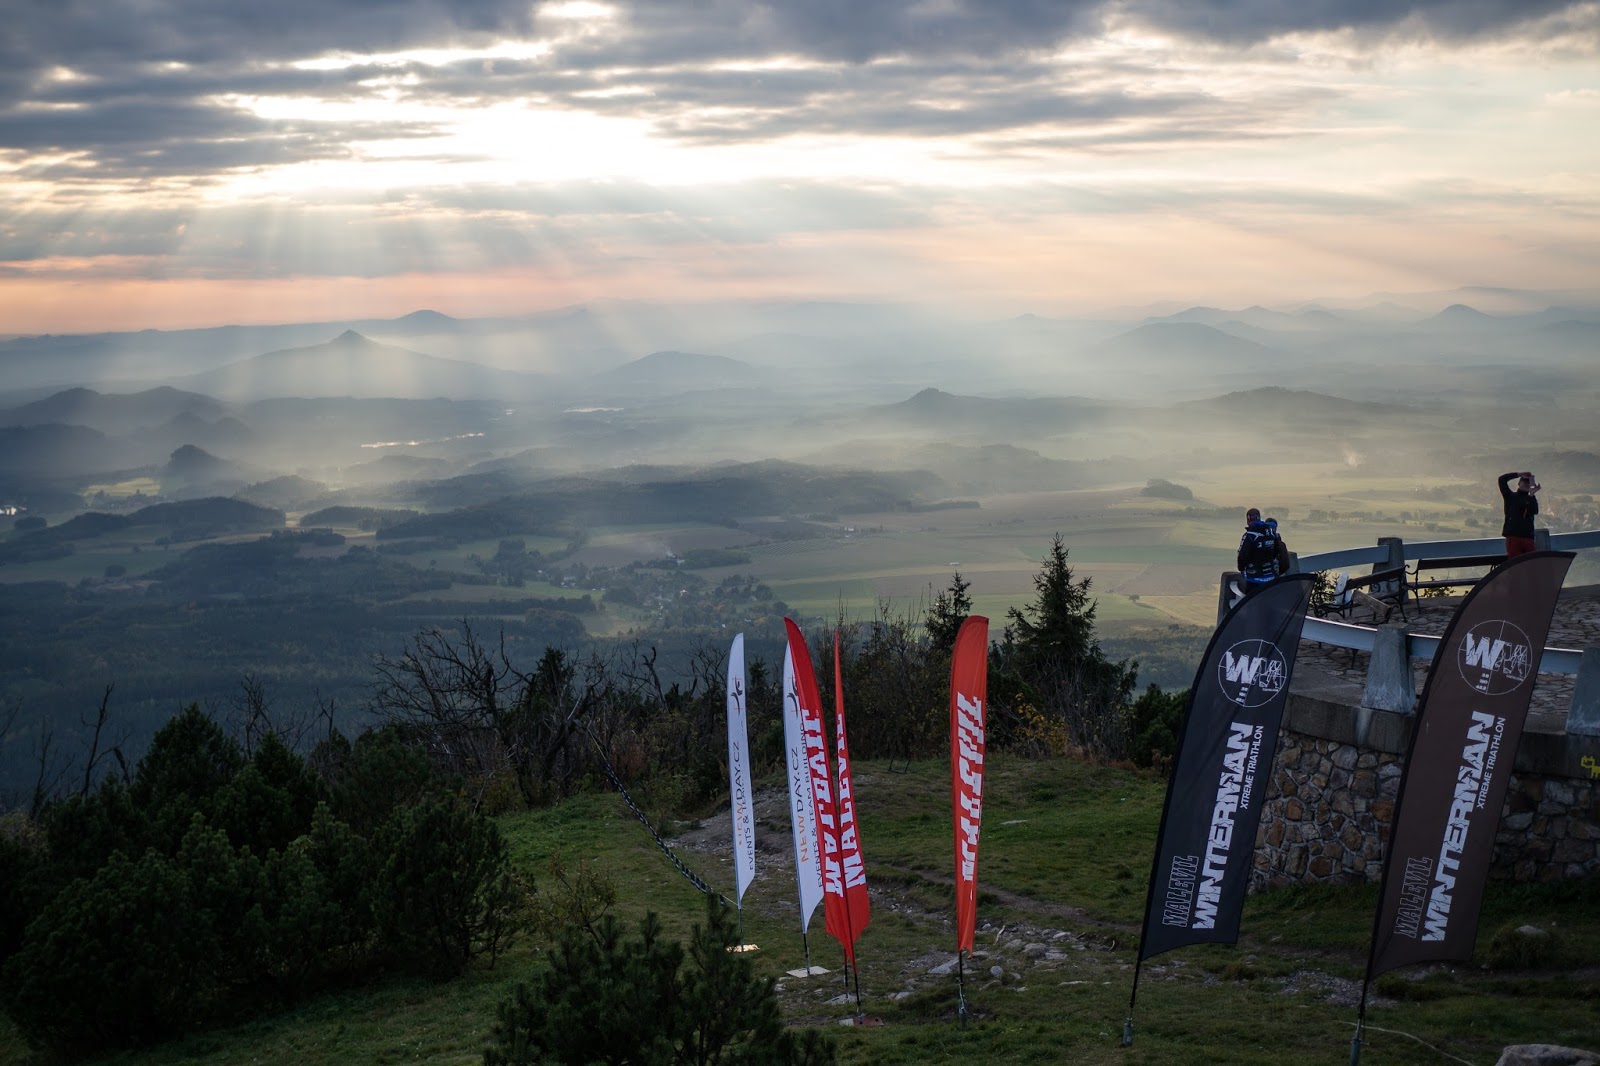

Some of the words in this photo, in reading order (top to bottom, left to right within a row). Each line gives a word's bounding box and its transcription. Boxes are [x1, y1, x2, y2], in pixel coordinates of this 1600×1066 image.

[791, 746, 809, 863] NEWDAY.CZ
[1240, 773, 1254, 809] XTREME
[1247, 725, 1264, 773] TRIATHLON
[1476, 771, 1492, 810] XTREME
[1486, 717, 1506, 771] TRIATHLON
[1192, 721, 1253, 930] WINTERMAN
[1421, 711, 1495, 942] WINTERMAN
[1162, 855, 1199, 928] MALEVIL
[1394, 857, 1432, 939] MALEVIL
